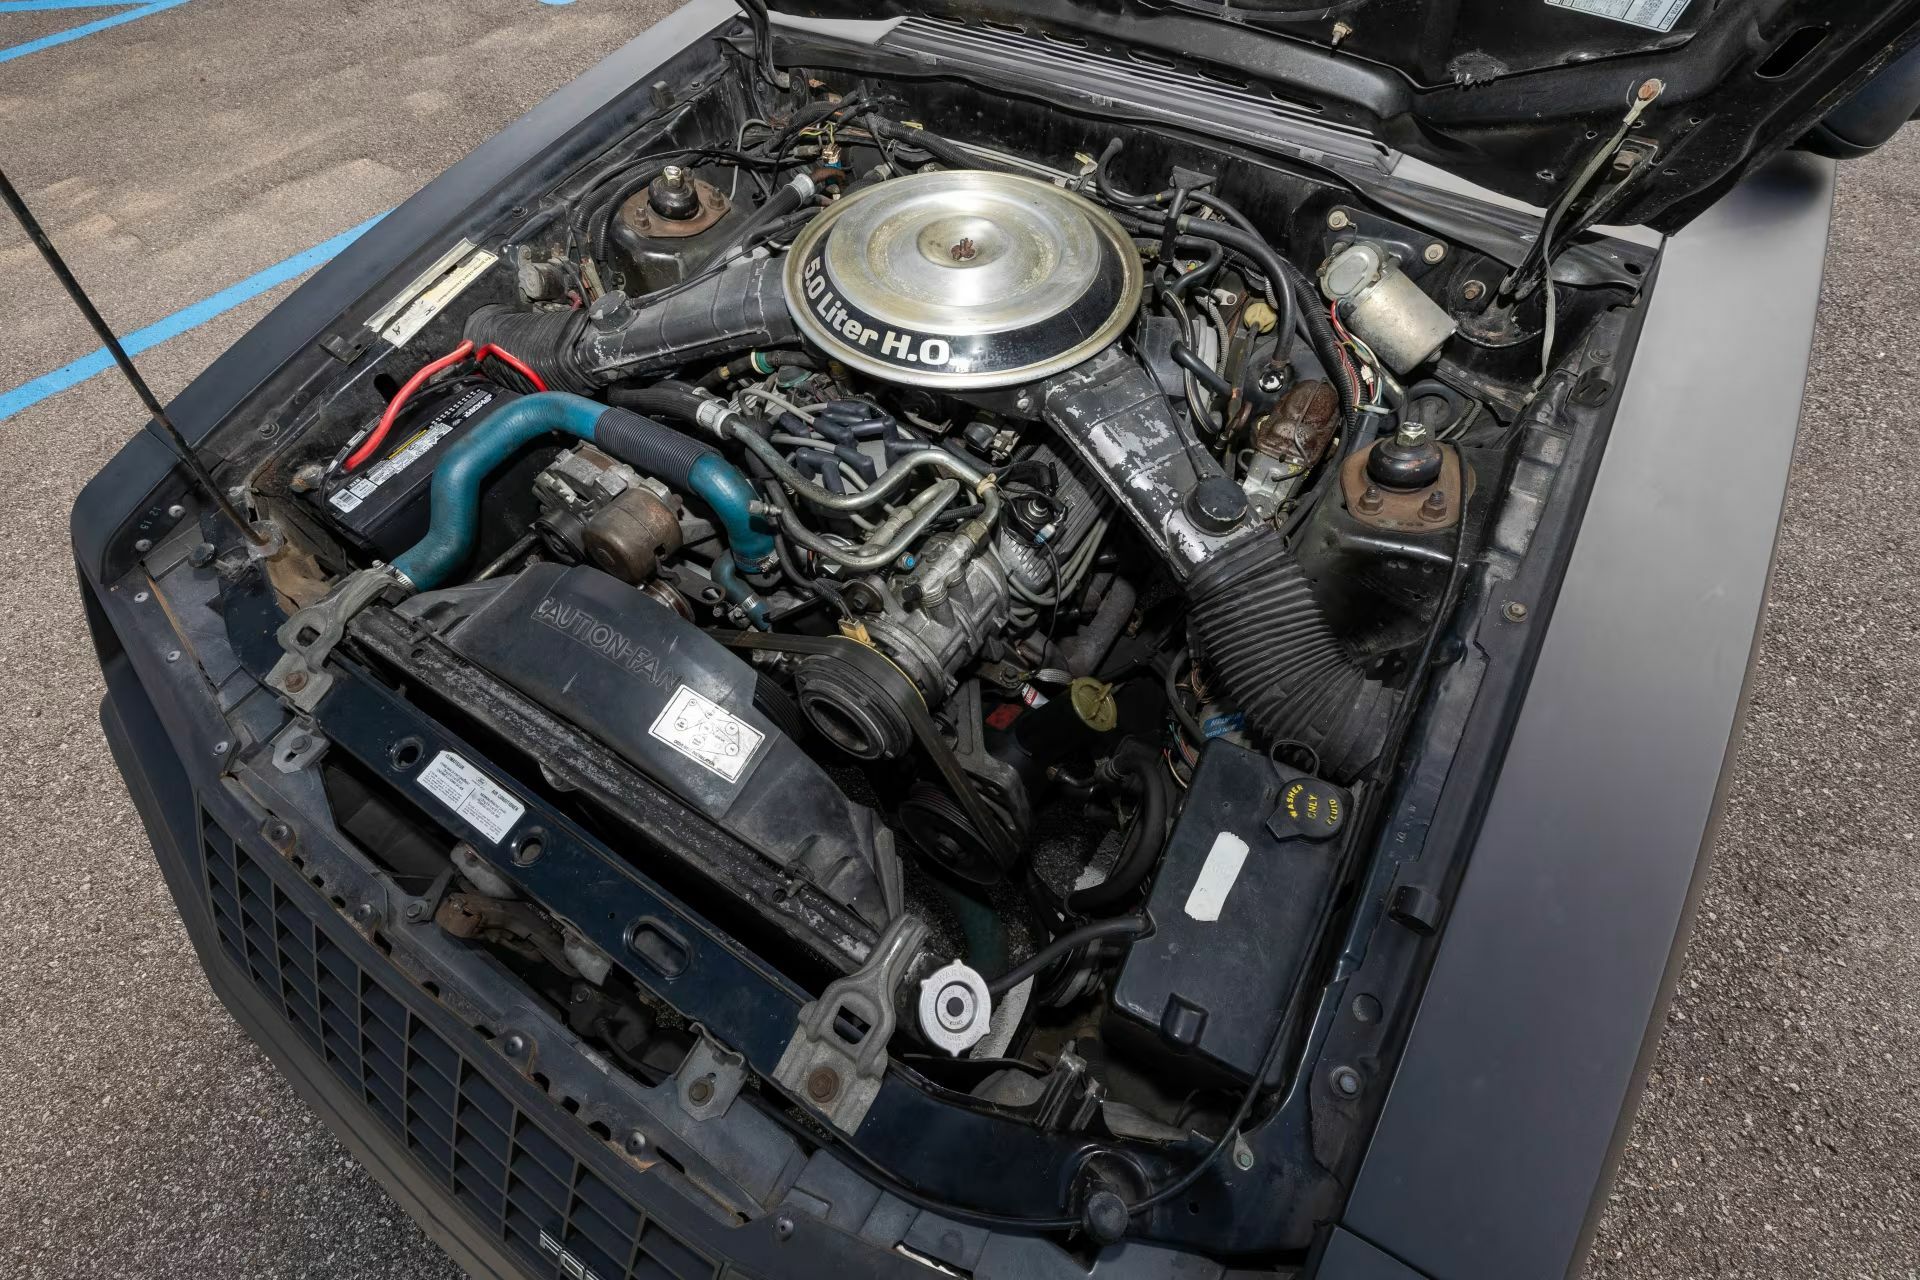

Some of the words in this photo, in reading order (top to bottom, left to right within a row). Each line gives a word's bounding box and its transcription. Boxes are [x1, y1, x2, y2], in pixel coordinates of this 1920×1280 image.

[804, 256, 826, 300] 5.0
[816, 292, 879, 346] Liter
[1306, 794, 1318, 819] ONLY
